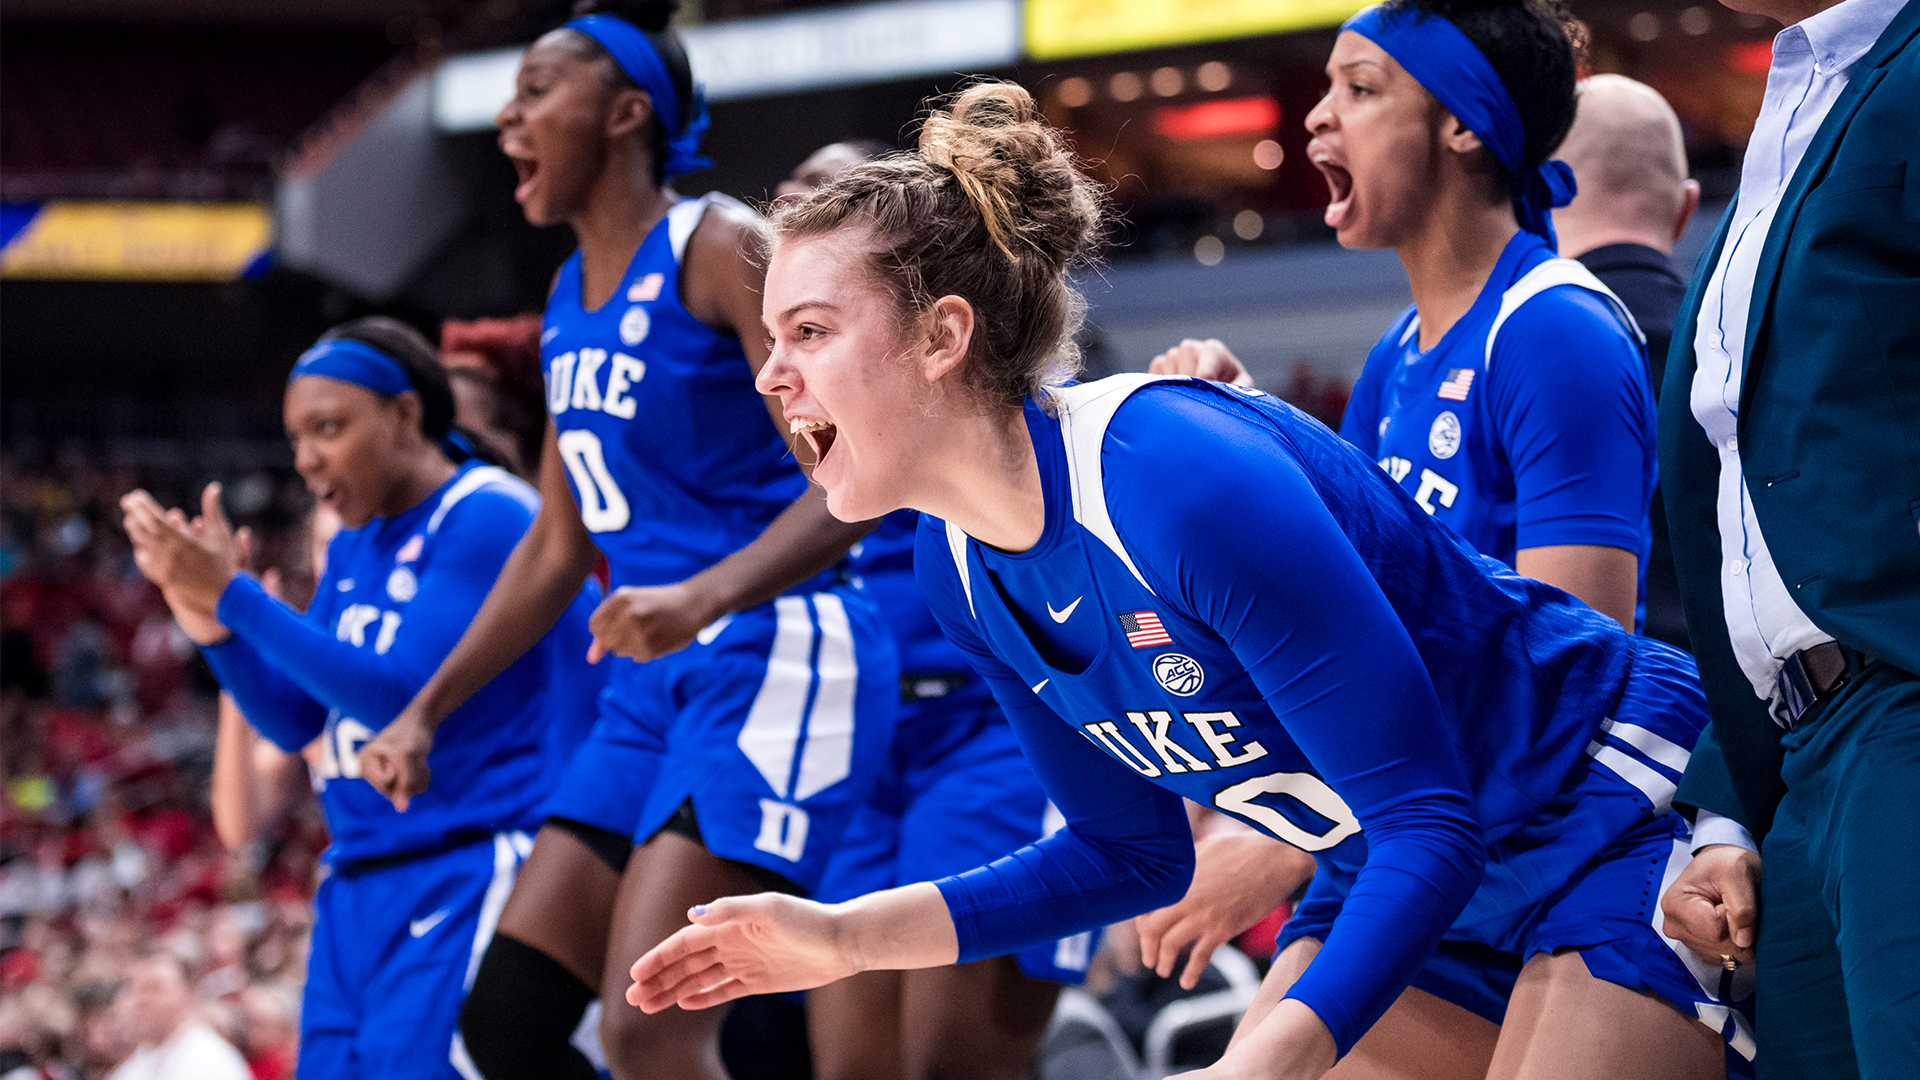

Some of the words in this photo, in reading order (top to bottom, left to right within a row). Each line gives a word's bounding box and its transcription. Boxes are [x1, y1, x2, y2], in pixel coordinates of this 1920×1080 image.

[544, 347, 646, 420] UKE
[558, 429, 630, 533] 0
[1165, 659, 1195, 681] ACC
[1078, 710, 1270, 778] UKE
[754, 798, 810, 863] D
[1213, 772, 1362, 852] 0
